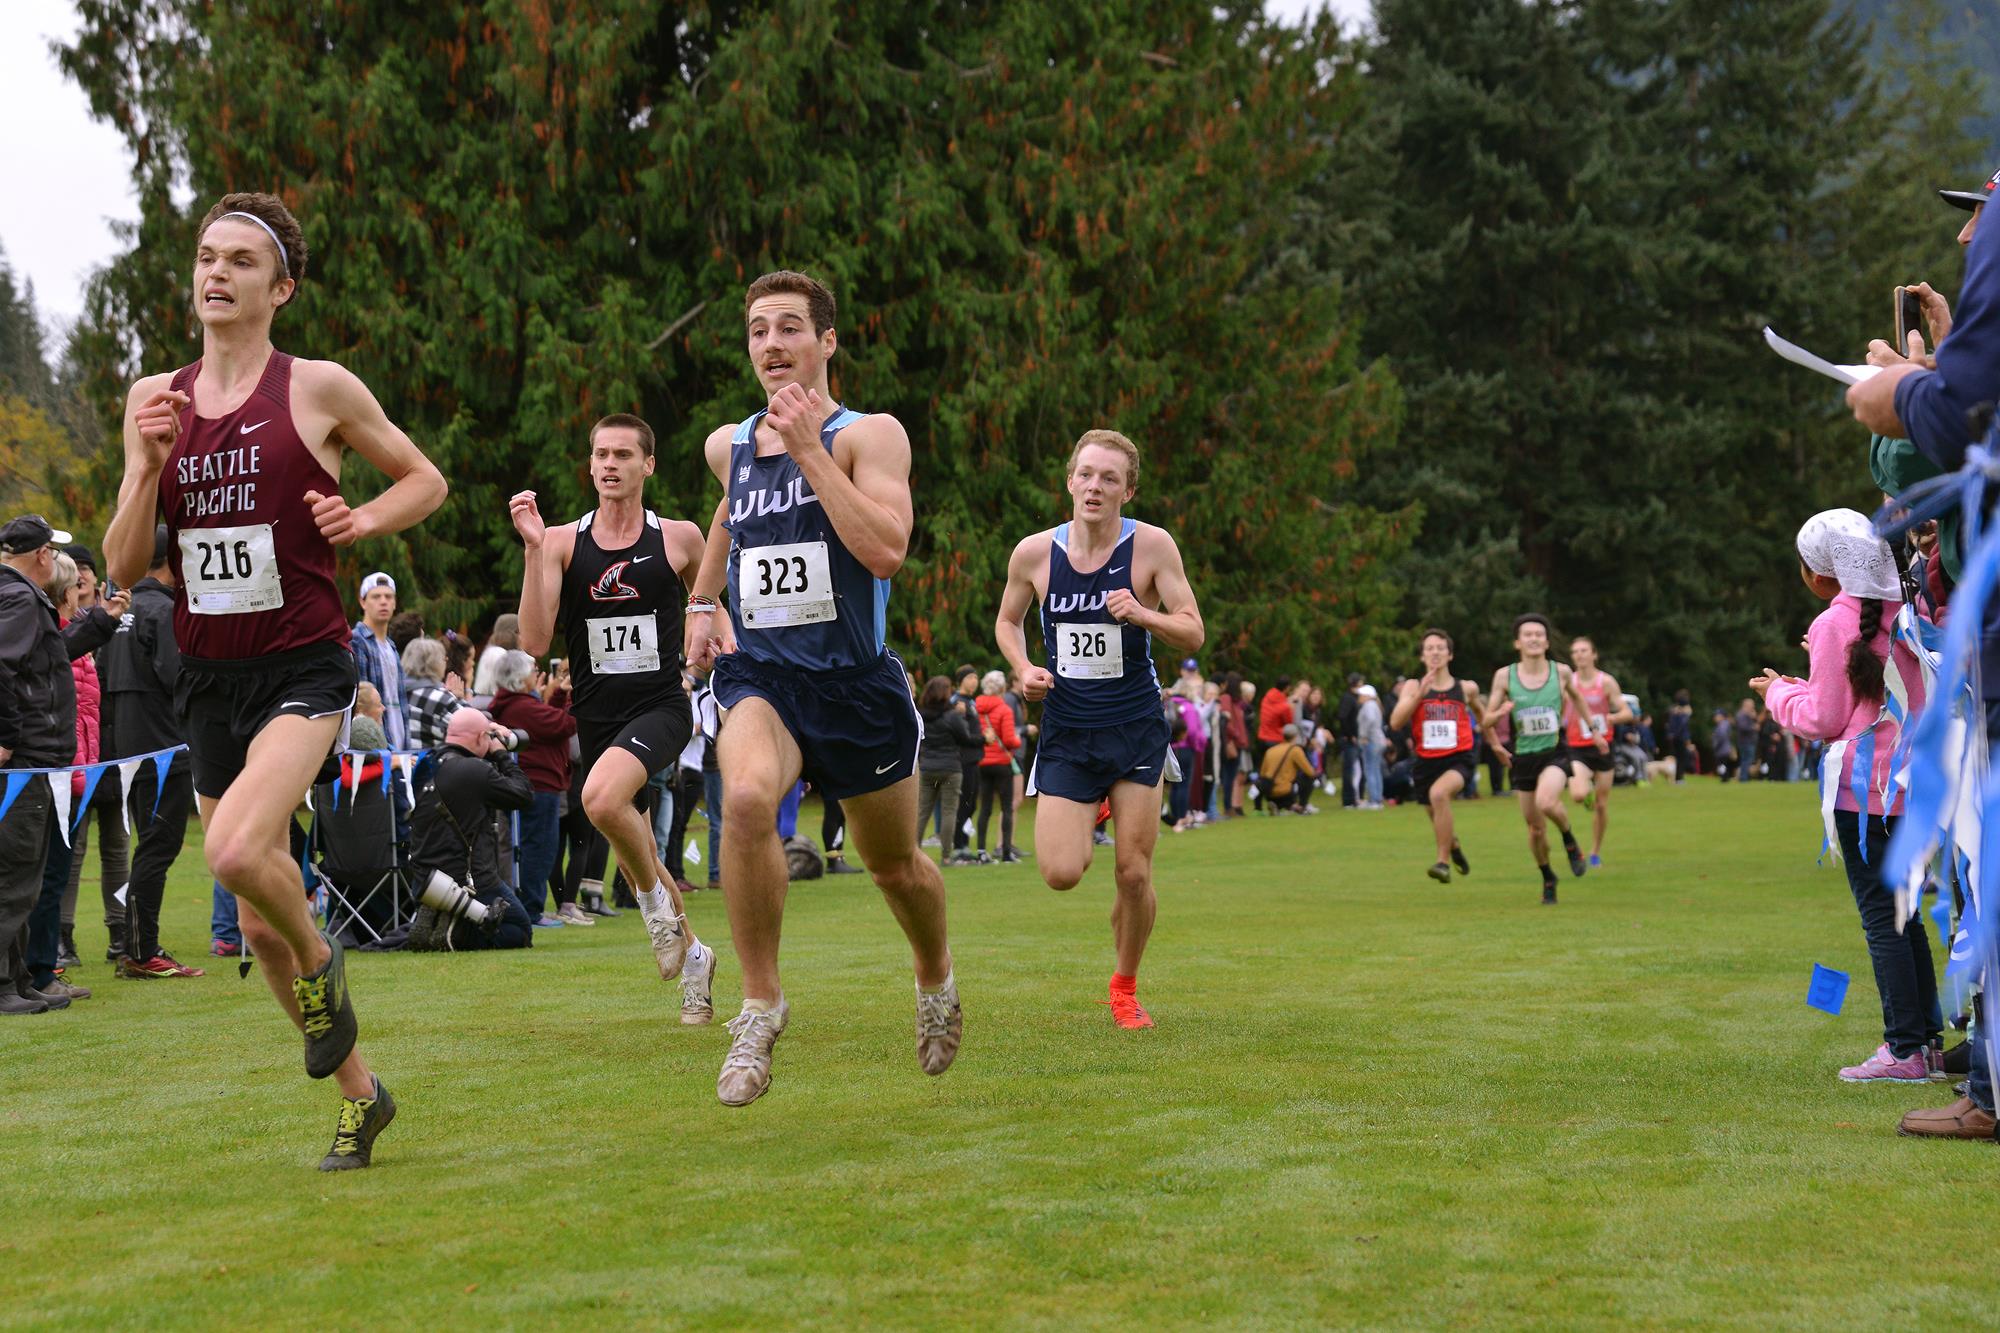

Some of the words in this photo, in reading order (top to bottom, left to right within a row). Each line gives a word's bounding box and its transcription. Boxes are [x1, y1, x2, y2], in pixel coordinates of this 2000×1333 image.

[177, 445, 260, 484] SEATTLE
[184, 483, 256, 517] PACIFIC
[197, 540, 252, 580] 216
[757, 556, 809, 596] 323
[1050, 589, 1131, 613] WW
[602, 625, 641, 652] 174
[1069, 632, 1107, 658] 326
[1430, 724, 1449, 738] 199
[1530, 717, 1551, 731] 162
